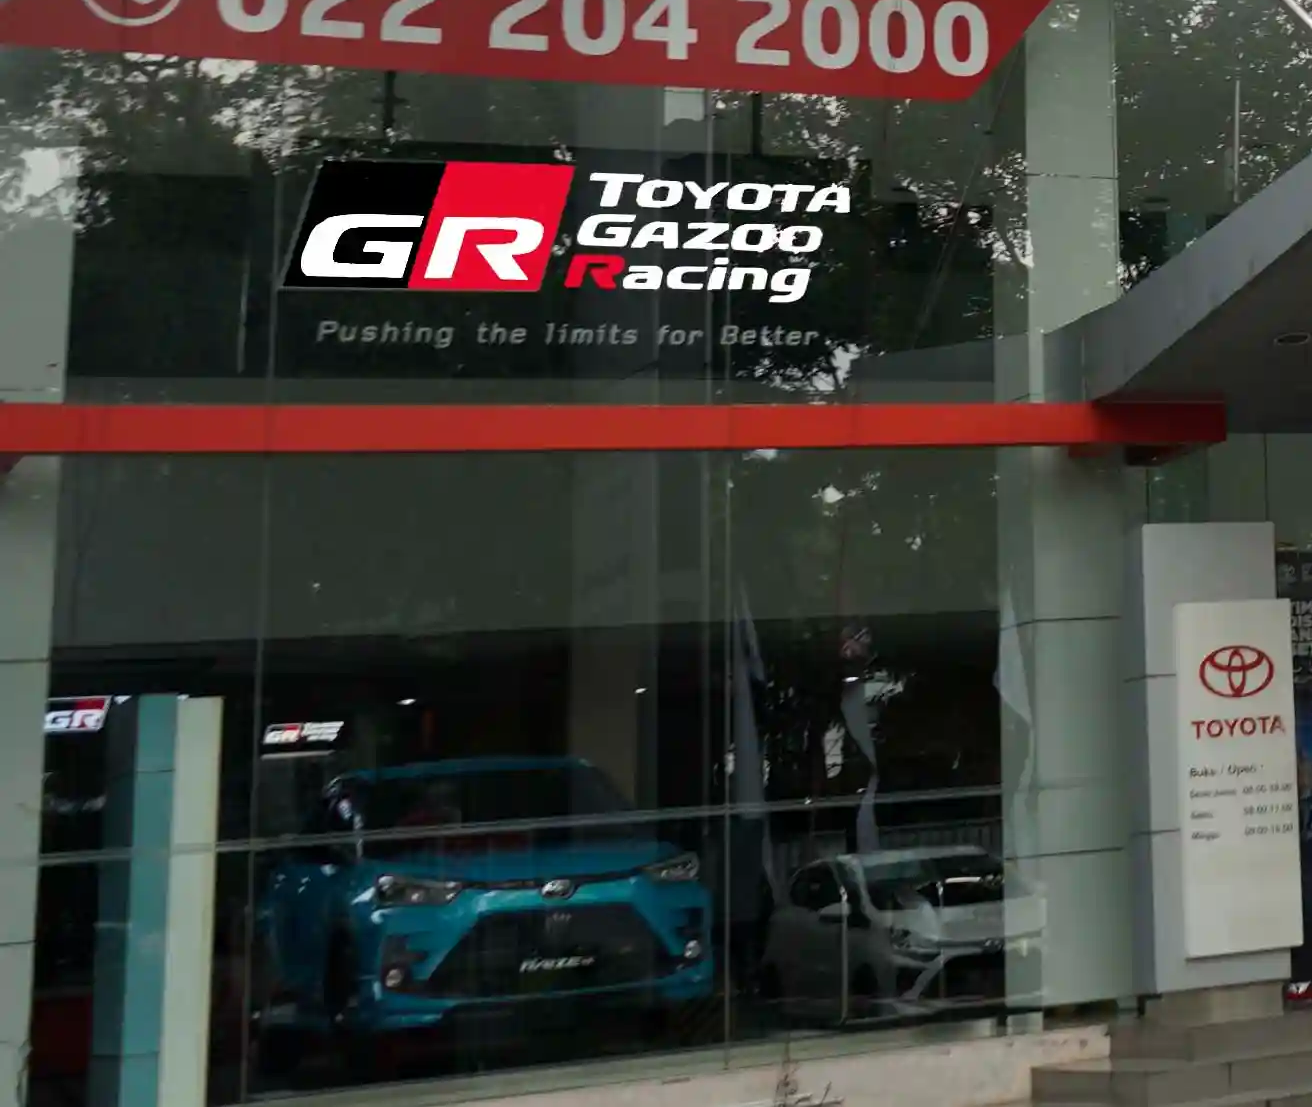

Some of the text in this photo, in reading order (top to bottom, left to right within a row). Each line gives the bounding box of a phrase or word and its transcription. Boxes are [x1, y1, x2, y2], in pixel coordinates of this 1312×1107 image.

[300, 173, 852, 280] GR TOYOTA
[577, 214, 822, 252] GAZOO
[564, 254, 811, 303] Racing
[316, 320, 454, 348] Pushing
[477, 321, 527, 346] the
[546, 321, 638, 347] limits
[658, 324, 703, 347] for
[45, 709, 103, 730] GR
[1190, 715, 1287, 740] TOYOTA
